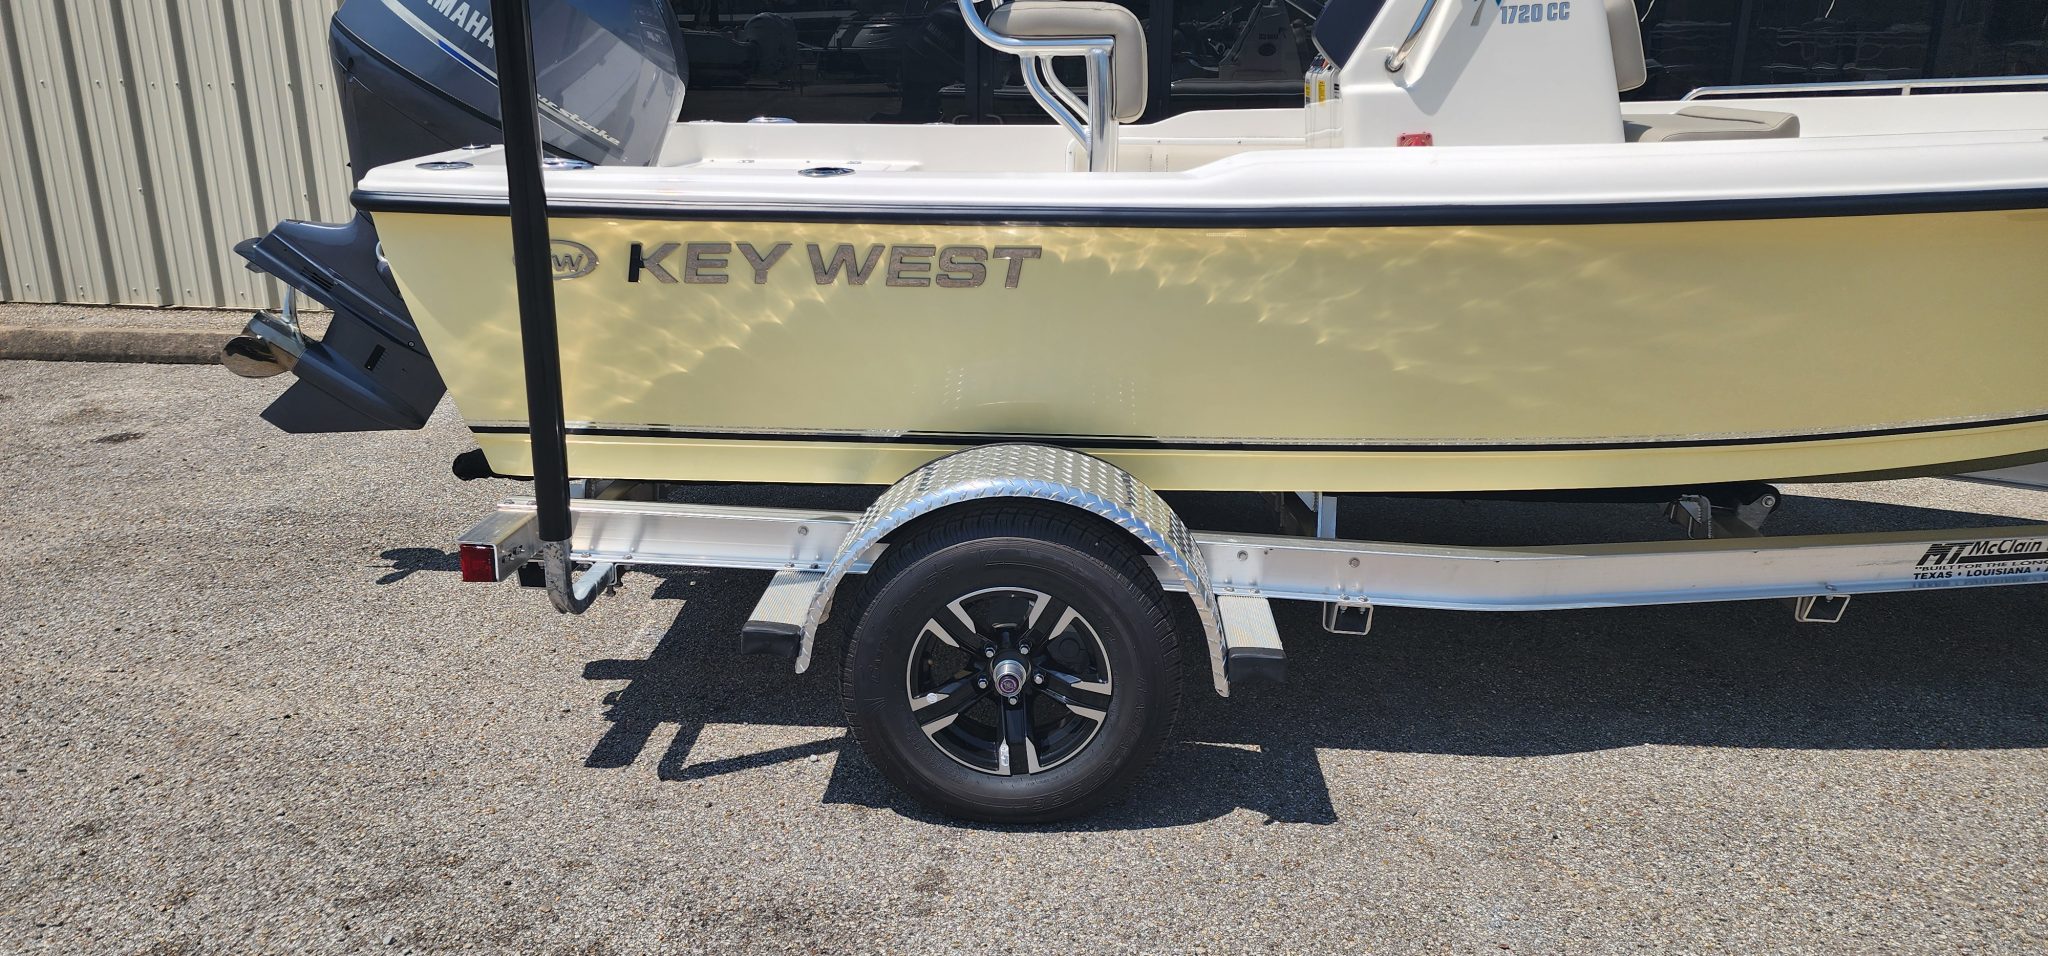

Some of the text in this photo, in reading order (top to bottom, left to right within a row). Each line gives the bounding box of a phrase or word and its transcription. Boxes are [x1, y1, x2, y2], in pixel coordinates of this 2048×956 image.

[1500, 2, 1571, 24] 1720 CC
[427, 0, 494, 49] MAHA
[627, 242, 1042, 288] KEY WEST
[1968, 538, 2042, 555] McClain
[1913, 567, 2031, 580] TEXAS LOUISIANA
